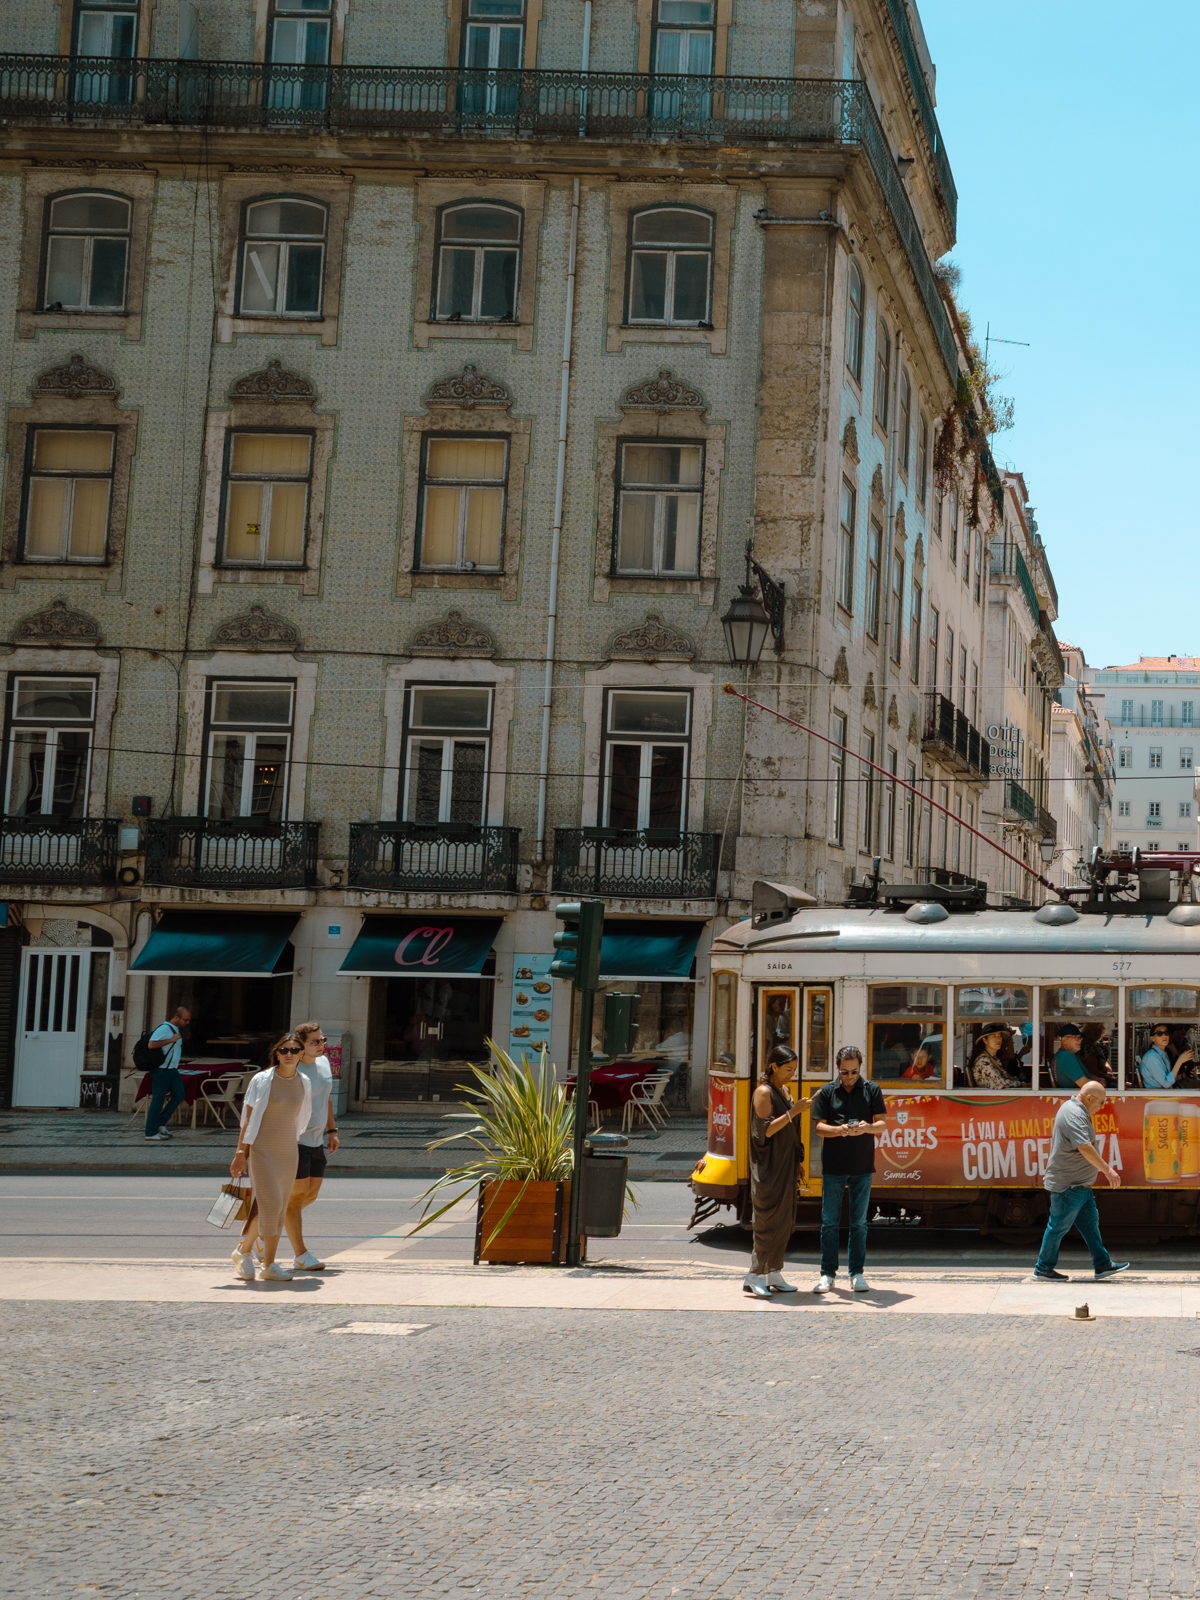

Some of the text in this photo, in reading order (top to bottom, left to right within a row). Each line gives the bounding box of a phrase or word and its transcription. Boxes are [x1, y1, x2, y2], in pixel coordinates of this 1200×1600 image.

[985, 724, 1024, 743] OTEL
[990, 744, 1018, 759] Duas
[990, 762, 1022, 777] ações
[767, 961, 793, 970] SAÍDA
[1112, 961, 1132, 971] 577
[713, 1111, 731, 1126] SAGRES
[961, 1118, 975, 1142] LÁ
[977, 1121, 995, 1141] VAI
[998, 1120, 1006, 1139] A
[1008, 1118, 1043, 1138] ALMA
[1158, 1118, 1169, 1149] SAGRES
[962, 1133, 1123, 1181] COM CEZA
